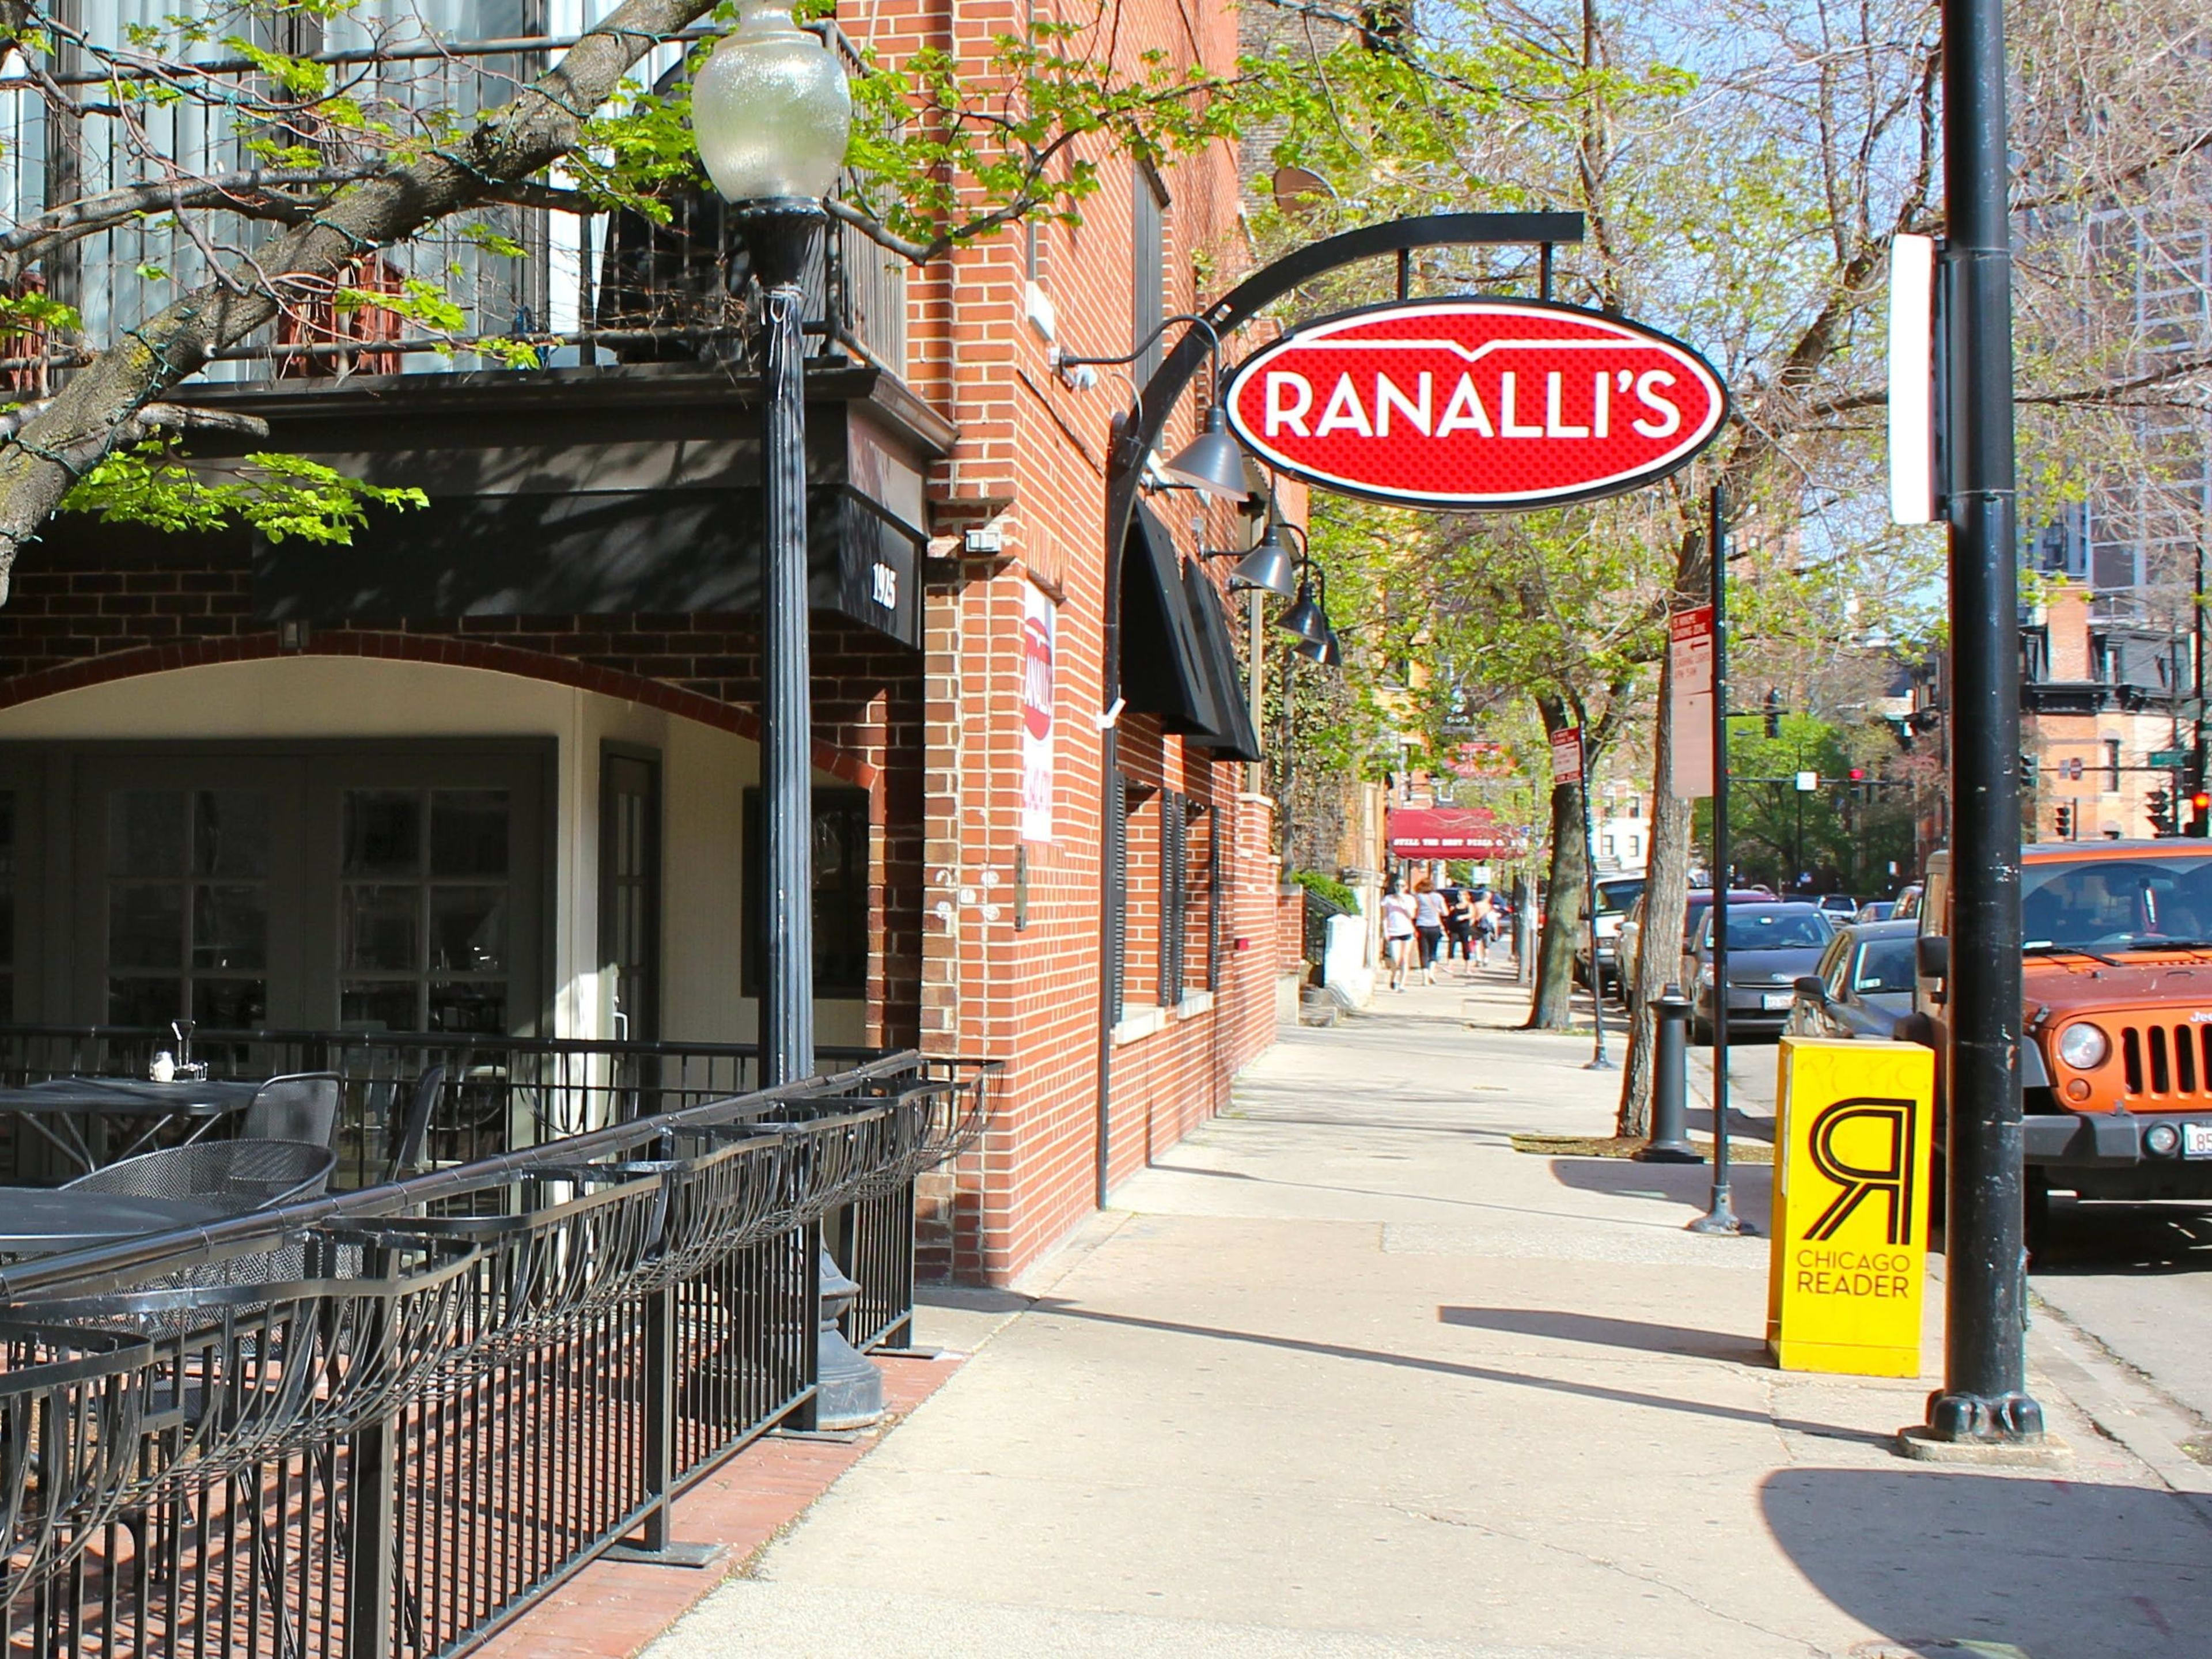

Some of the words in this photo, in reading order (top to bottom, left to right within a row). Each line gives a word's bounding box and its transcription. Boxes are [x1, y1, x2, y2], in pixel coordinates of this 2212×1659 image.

[1264, 369, 1681, 438] RANALLI'S
[873, 562, 896, 609] 1925
[1797, 1249, 1910, 1272] CHICAGO
[1797, 1271, 1909, 1298] READER
